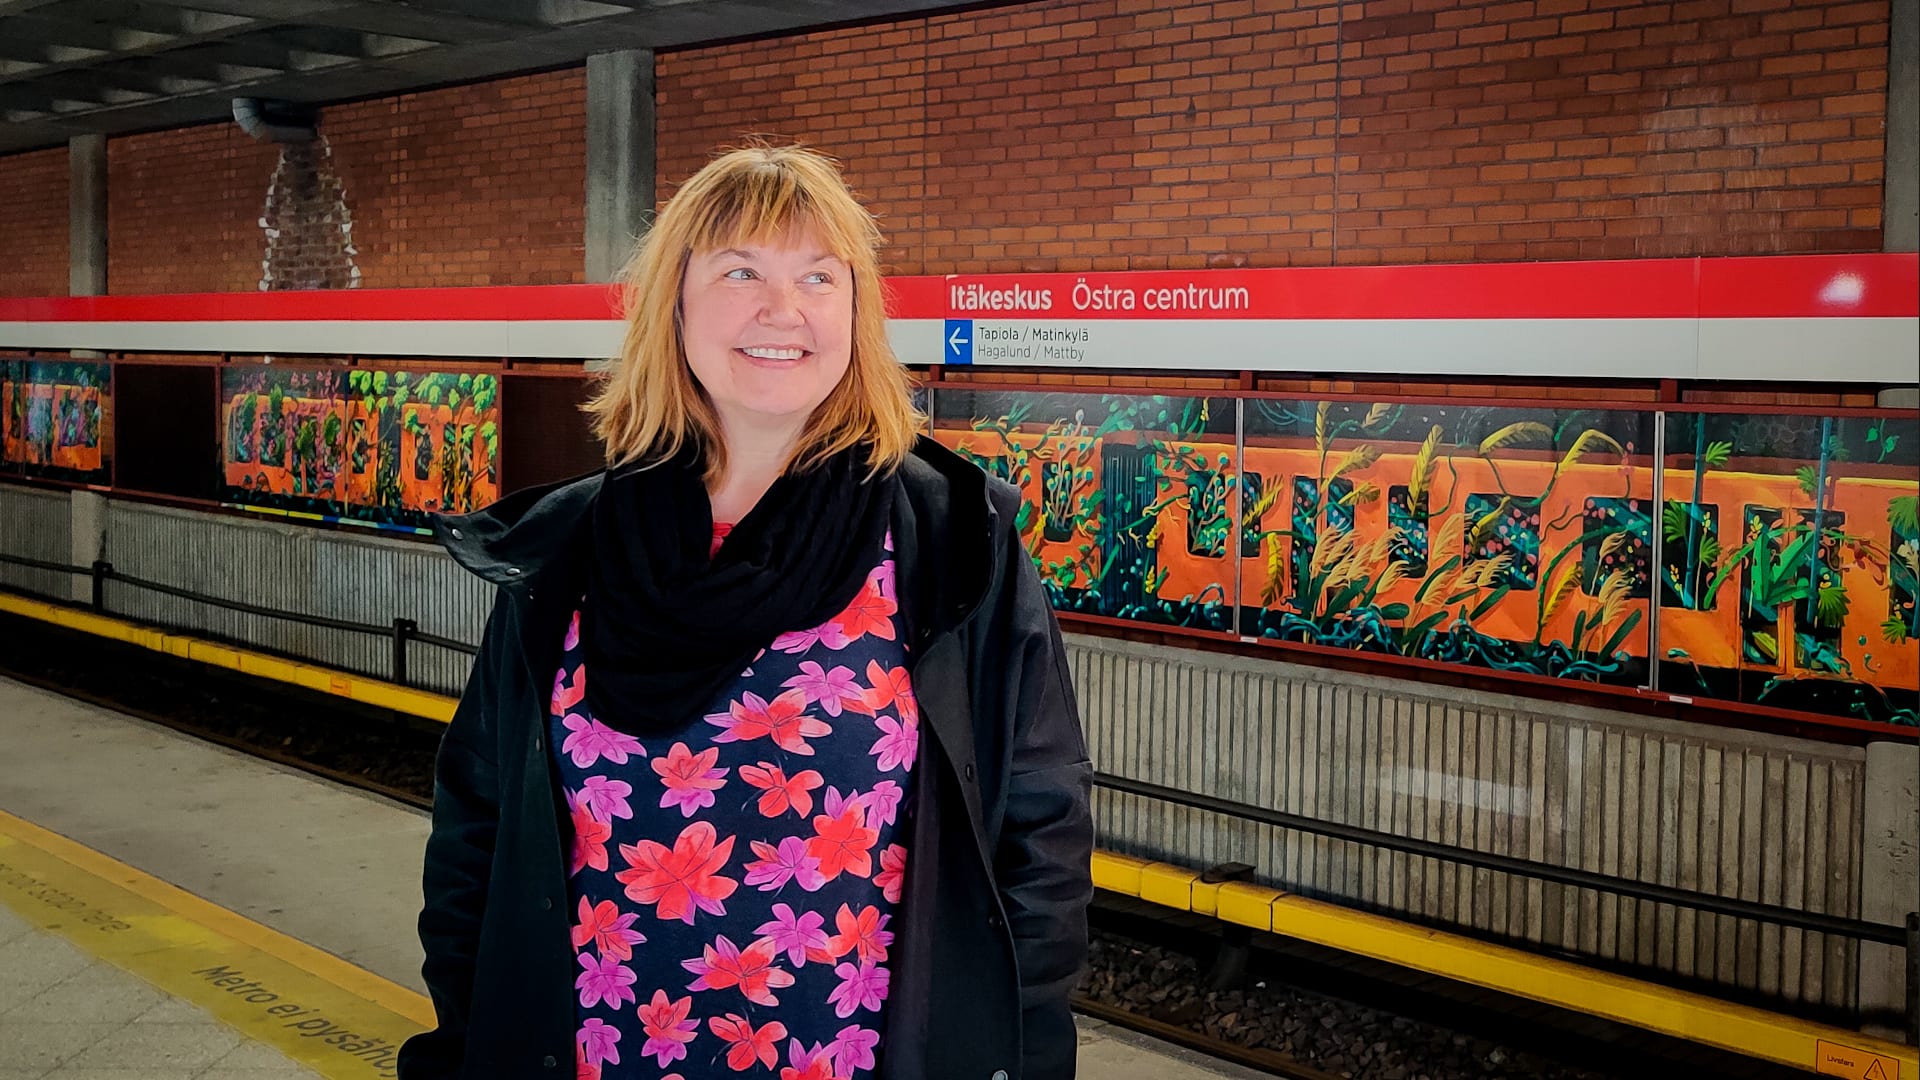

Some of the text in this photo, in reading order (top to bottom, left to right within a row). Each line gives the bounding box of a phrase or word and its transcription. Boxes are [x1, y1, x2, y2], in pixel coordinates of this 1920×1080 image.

[951, 277, 1249, 310] Itäkeskus Östra centrum
[979, 327, 1019, 342] Tapiola
[1032, 327, 1089, 344] Matinkylä
[978, 344, 1031, 360] Hagalund
[1044, 345, 1085, 362] Mattby
[192, 965, 396, 1077] Metro ei pysäh
